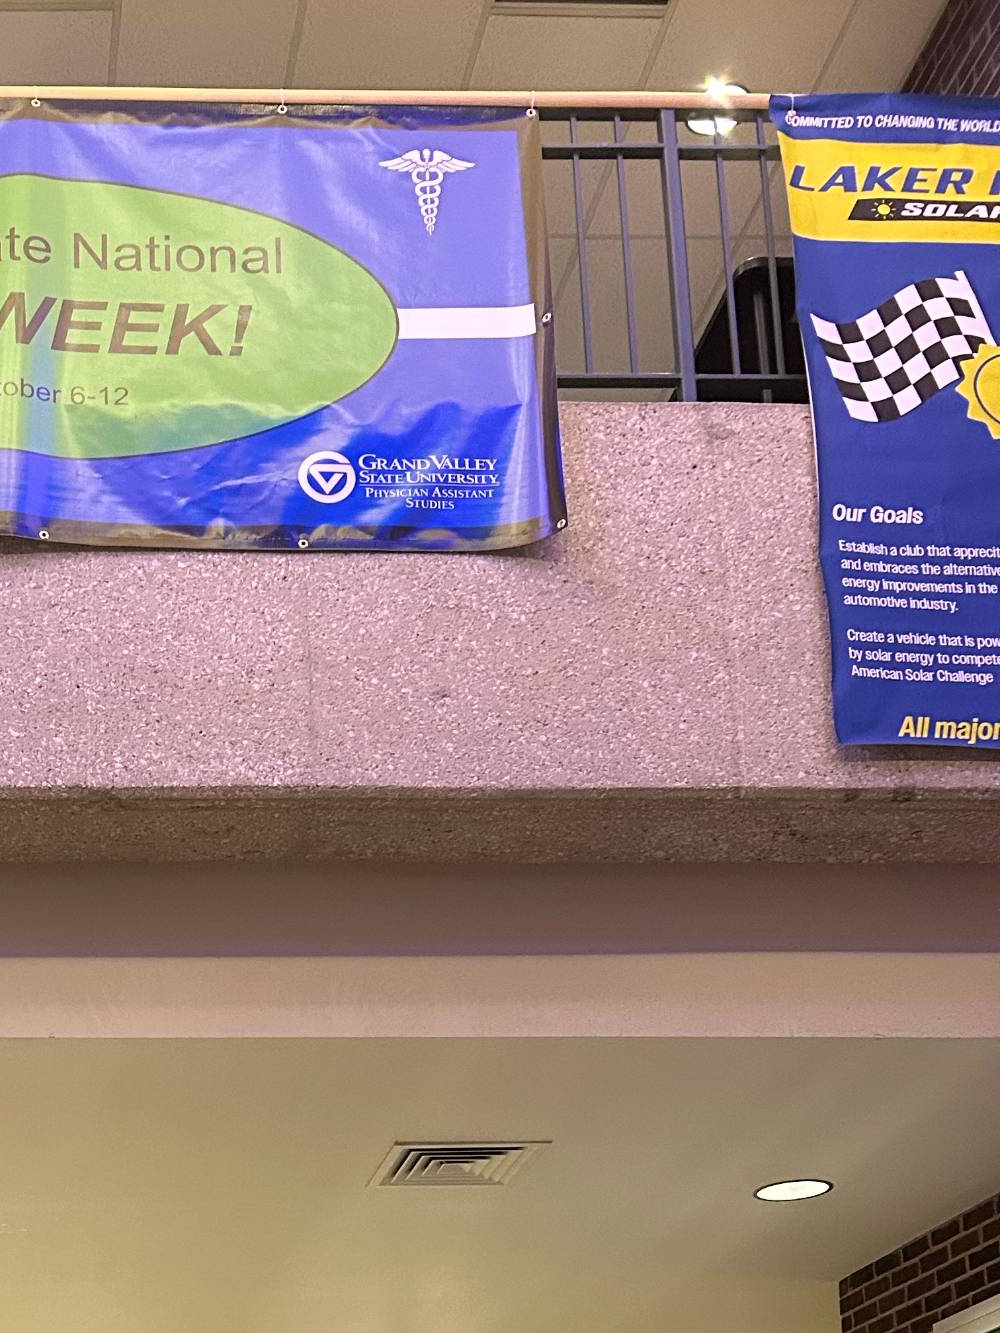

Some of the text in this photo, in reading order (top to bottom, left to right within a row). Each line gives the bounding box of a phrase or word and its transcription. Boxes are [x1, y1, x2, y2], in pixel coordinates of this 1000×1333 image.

[856, 116, 873, 128] TO
[875, 115, 934, 128] CHANGING
[937, 118, 959, 131] THE
[789, 165, 974, 195] LAKER
[73, 232, 283, 275] National
[70, 386, 130, 406] 6-12
[358, 454, 497, 471] GRAND VALLEY
[359, 470, 500, 485] STATE UNIVERSITY
[365, 487, 495, 498] PHYSICIAN ASSISTANT
[406, 498, 455, 510] STUDIES
[832, 504, 924, 525] Our Goals
[838, 540, 888, 556] Establish
[890, 547, 898, 557] a
[899, 545, 924, 557] club
[926, 546, 952, 558] that
[841, 559, 861, 571] and
[863, 562, 919, 575] embraces
[921, 563, 941, 575] the
[842, 576, 998, 595] energy improvements in the
[843, 594, 959, 614] automotive industry.
[847, 628, 885, 643] Create
[886, 634, 894, 644] a
[896, 632, 936, 646] vehicle
[938, 634, 963, 647] that
[964, 636, 975, 648] is
[848, 647, 863, 662] by
[865, 649, 892, 662] solar
[894, 652, 934, 666] energy
[936, 653, 950, 665] to
[852, 665, 994, 686] American Solar Challenge
[898, 716, 930, 738] All
